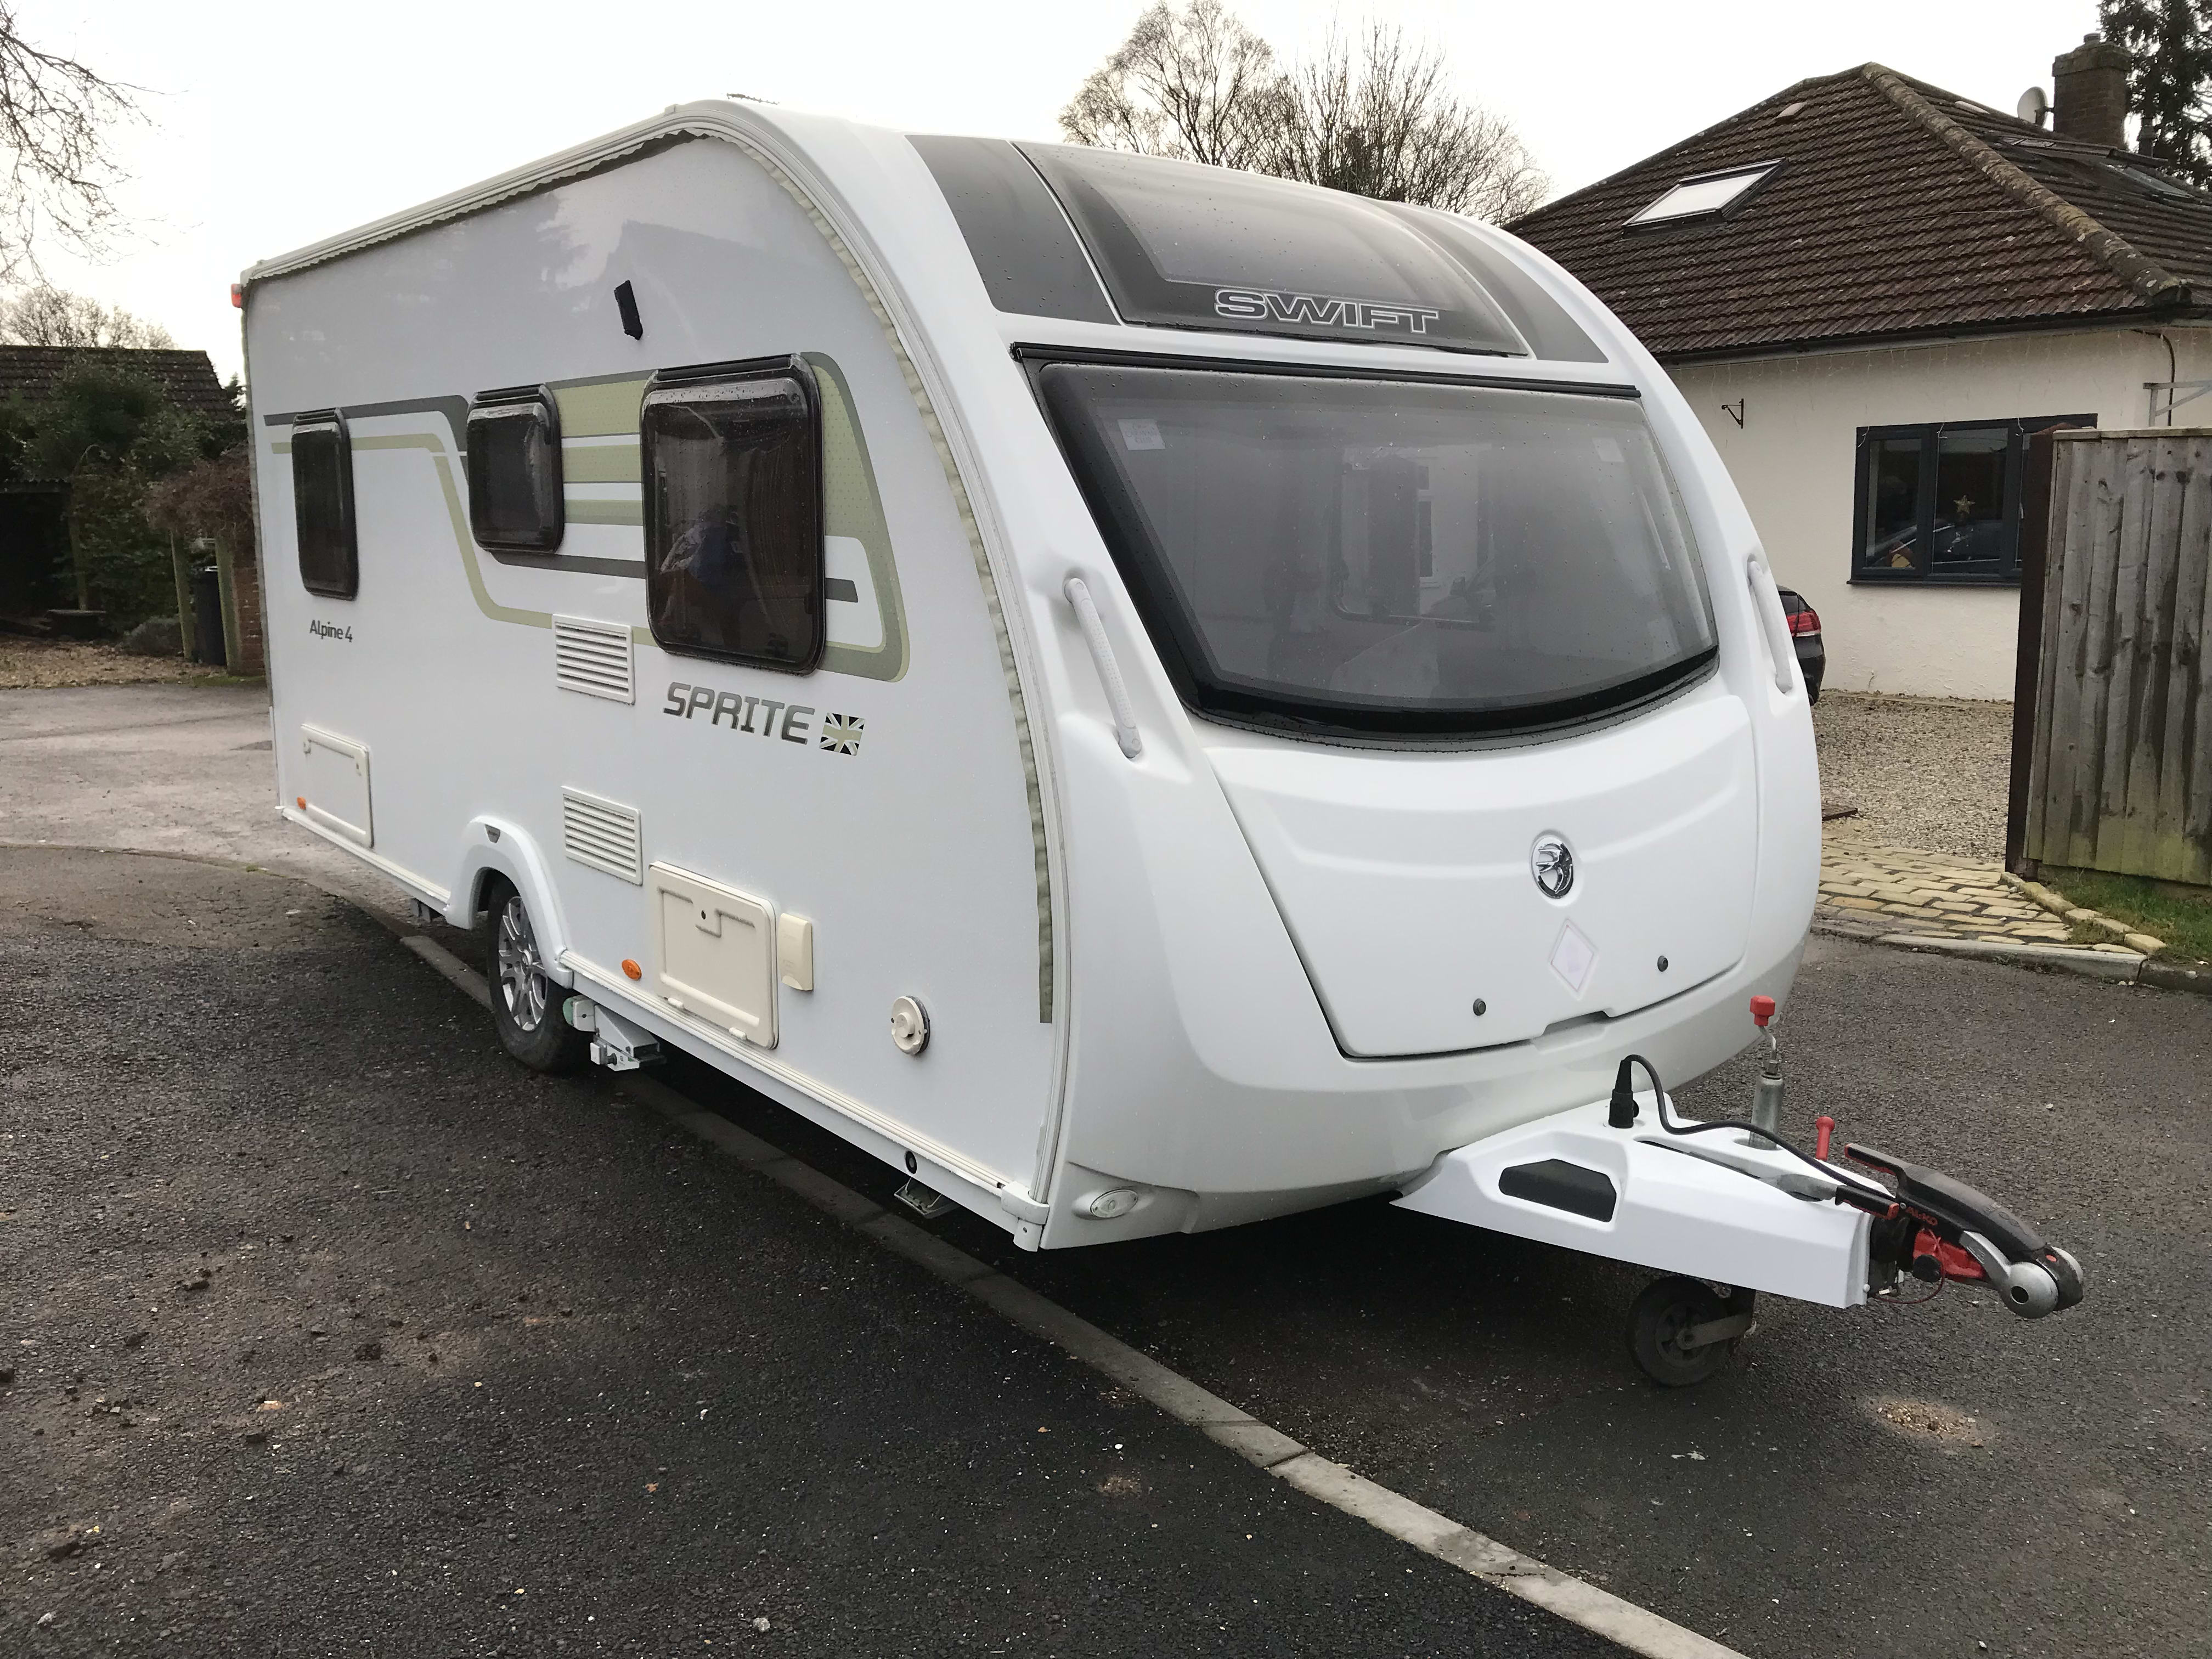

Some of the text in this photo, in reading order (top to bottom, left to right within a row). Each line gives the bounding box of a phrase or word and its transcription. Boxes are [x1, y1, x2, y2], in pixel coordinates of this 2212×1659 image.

[1214, 288, 1440, 334] SWIFT
[309, 619, 353, 642] Alpine 4
[663, 681, 815, 745] SPRITE
